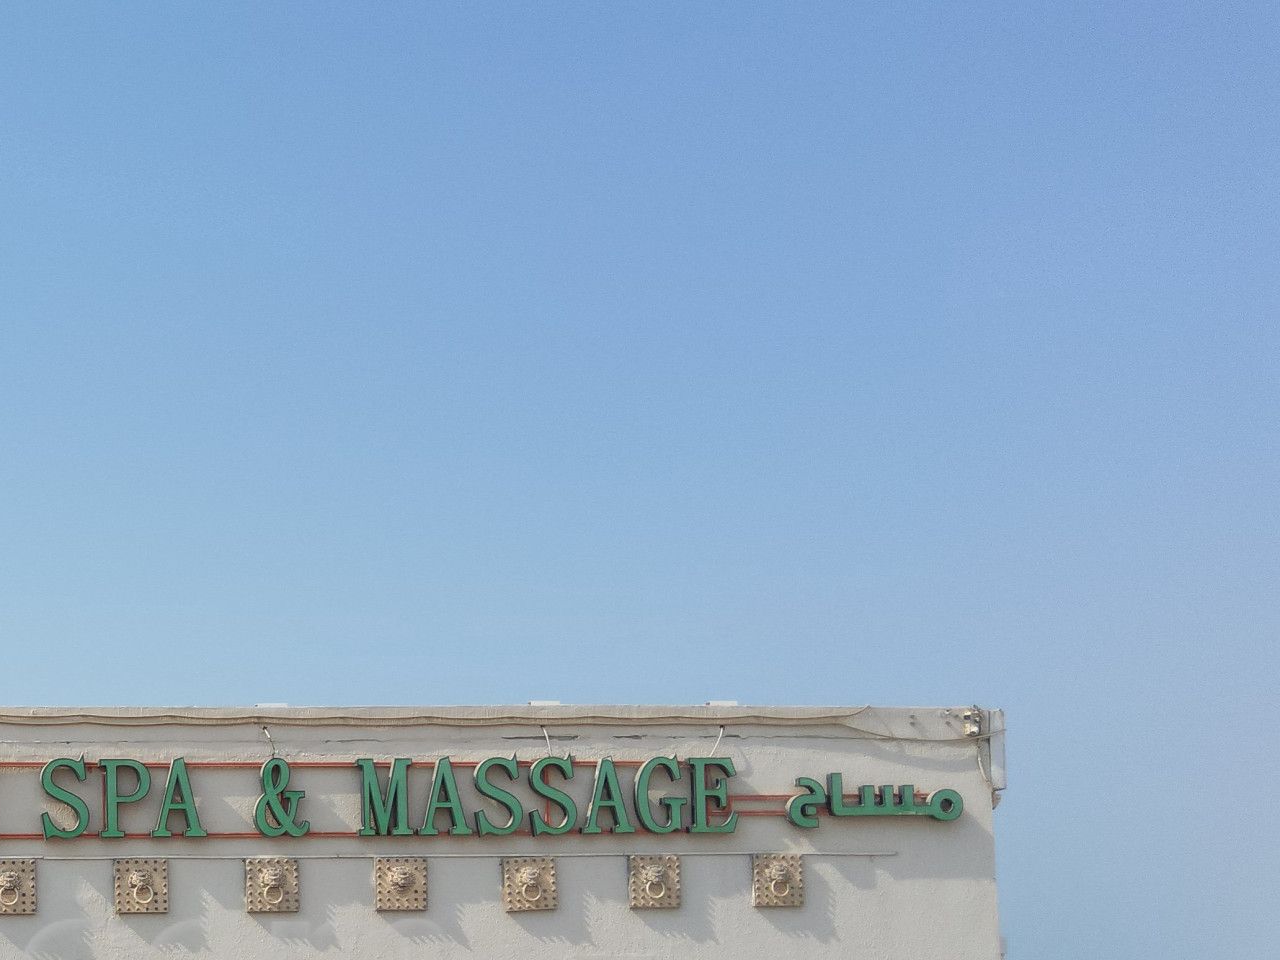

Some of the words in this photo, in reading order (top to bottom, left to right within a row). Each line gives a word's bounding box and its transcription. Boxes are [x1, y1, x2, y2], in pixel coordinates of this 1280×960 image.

[40, 753, 208, 842] SPA
[253, 757, 310, 838] &
[356, 752, 739, 838] MASSAGE
[786, 772, 964, 828] مساج
